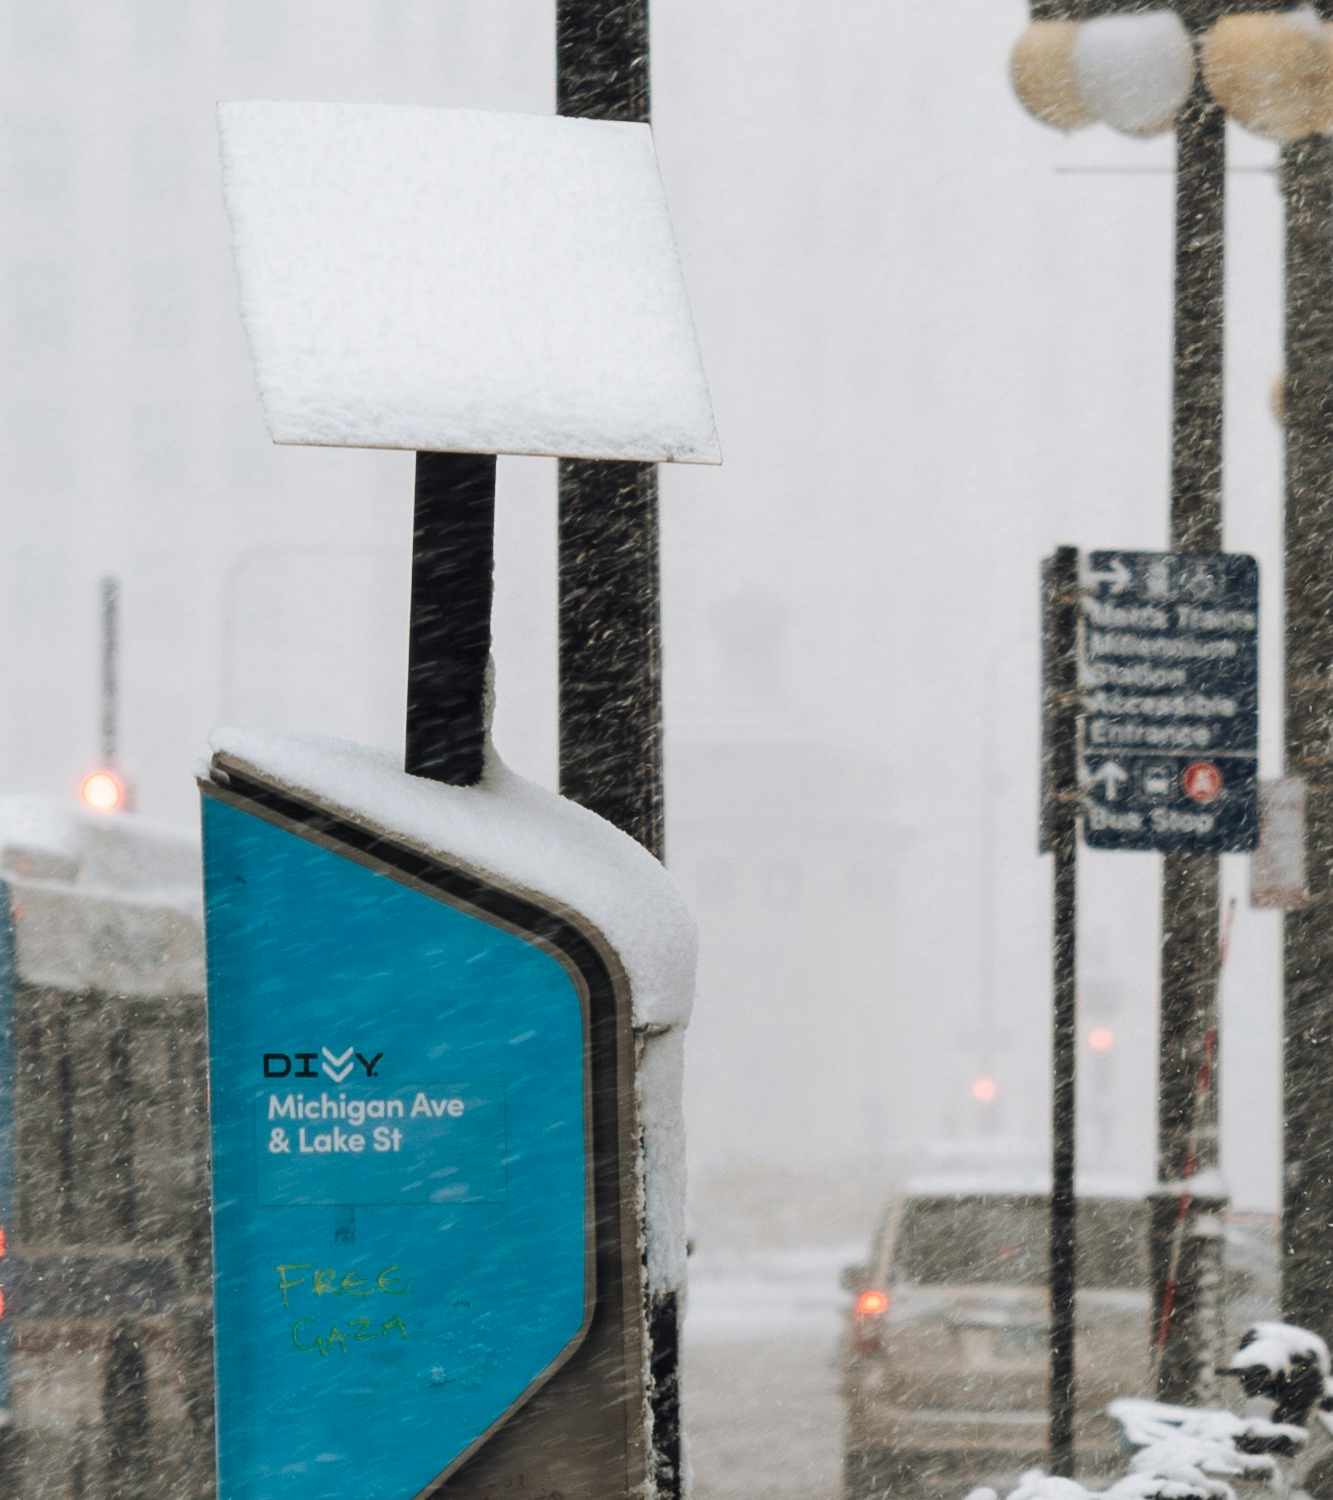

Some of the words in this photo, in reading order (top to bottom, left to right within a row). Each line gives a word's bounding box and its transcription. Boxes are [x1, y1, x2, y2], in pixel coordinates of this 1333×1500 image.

[1090, 807, 1143, 832] Bus
[1151, 806, 1214, 837] Stop
[268, 1092, 404, 1126] Michigan
[410, 1092, 465, 1118] Ave
[268, 1127, 291, 1154] &
[299, 1126, 366, 1153] Lake
[373, 1126, 403, 1153] St
[276, 1264, 412, 1309] FREE
[292, 1315, 410, 1358] GAZA
